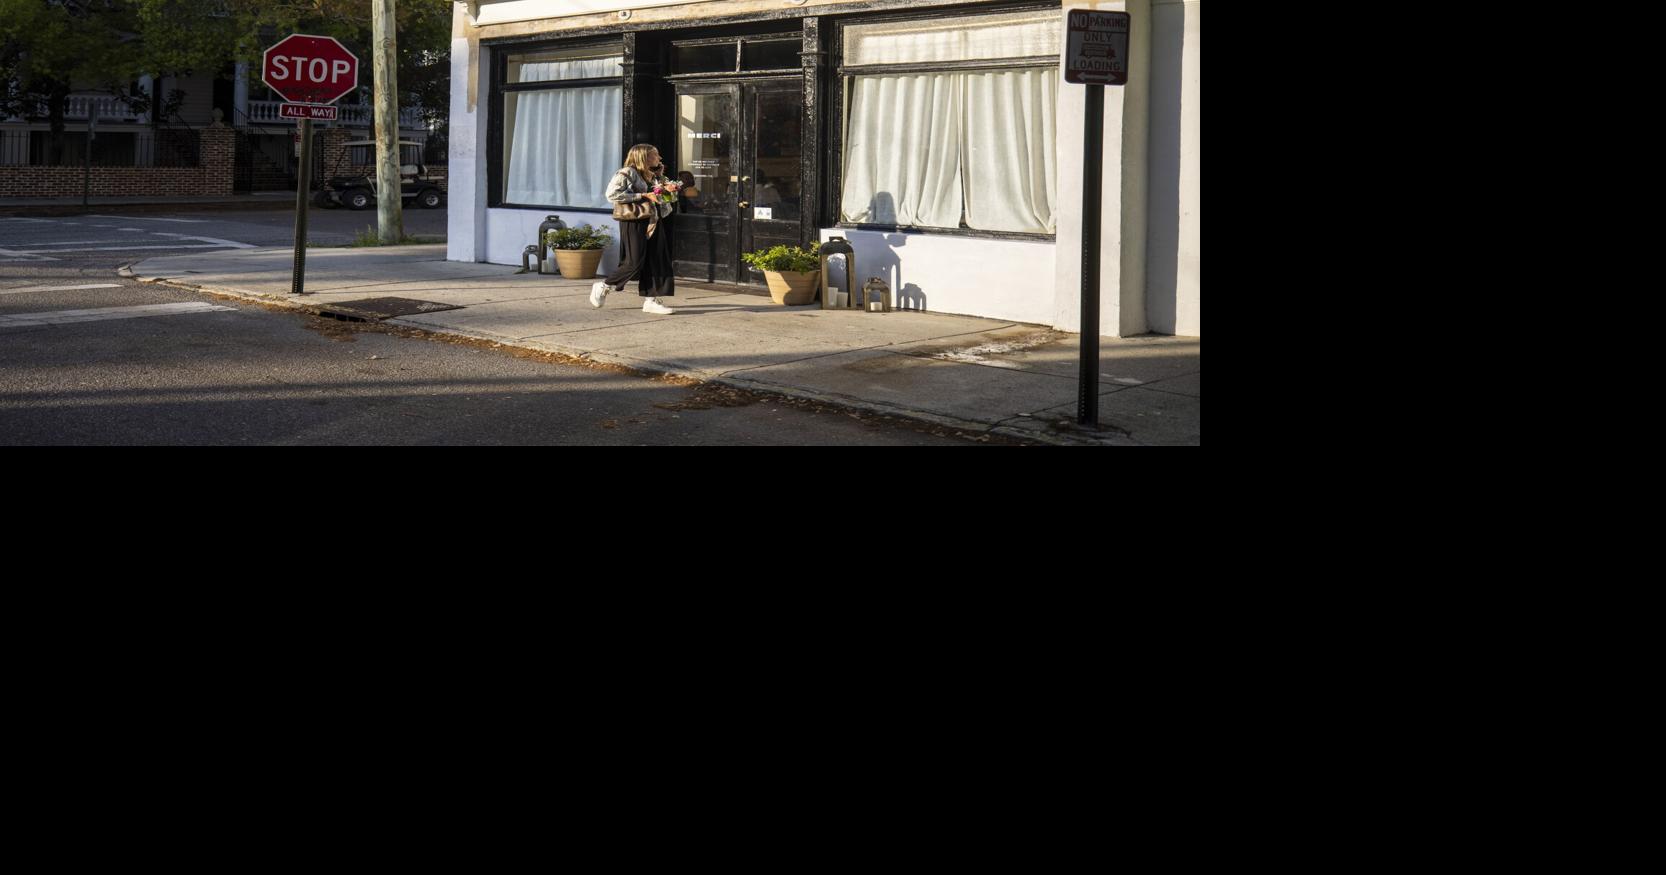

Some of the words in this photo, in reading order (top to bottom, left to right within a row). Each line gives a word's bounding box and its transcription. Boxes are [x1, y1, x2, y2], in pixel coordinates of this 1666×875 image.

[1071, 14, 1088, 28] NO
[1089, 15, 1126, 28] PARKING
[1083, 31, 1112, 42] ONLY
[270, 55, 351, 84] STOP
[1073, 60, 1120, 71] LOADING
[286, 106, 305, 116] ALL
[310, 107, 330, 117] WAY
